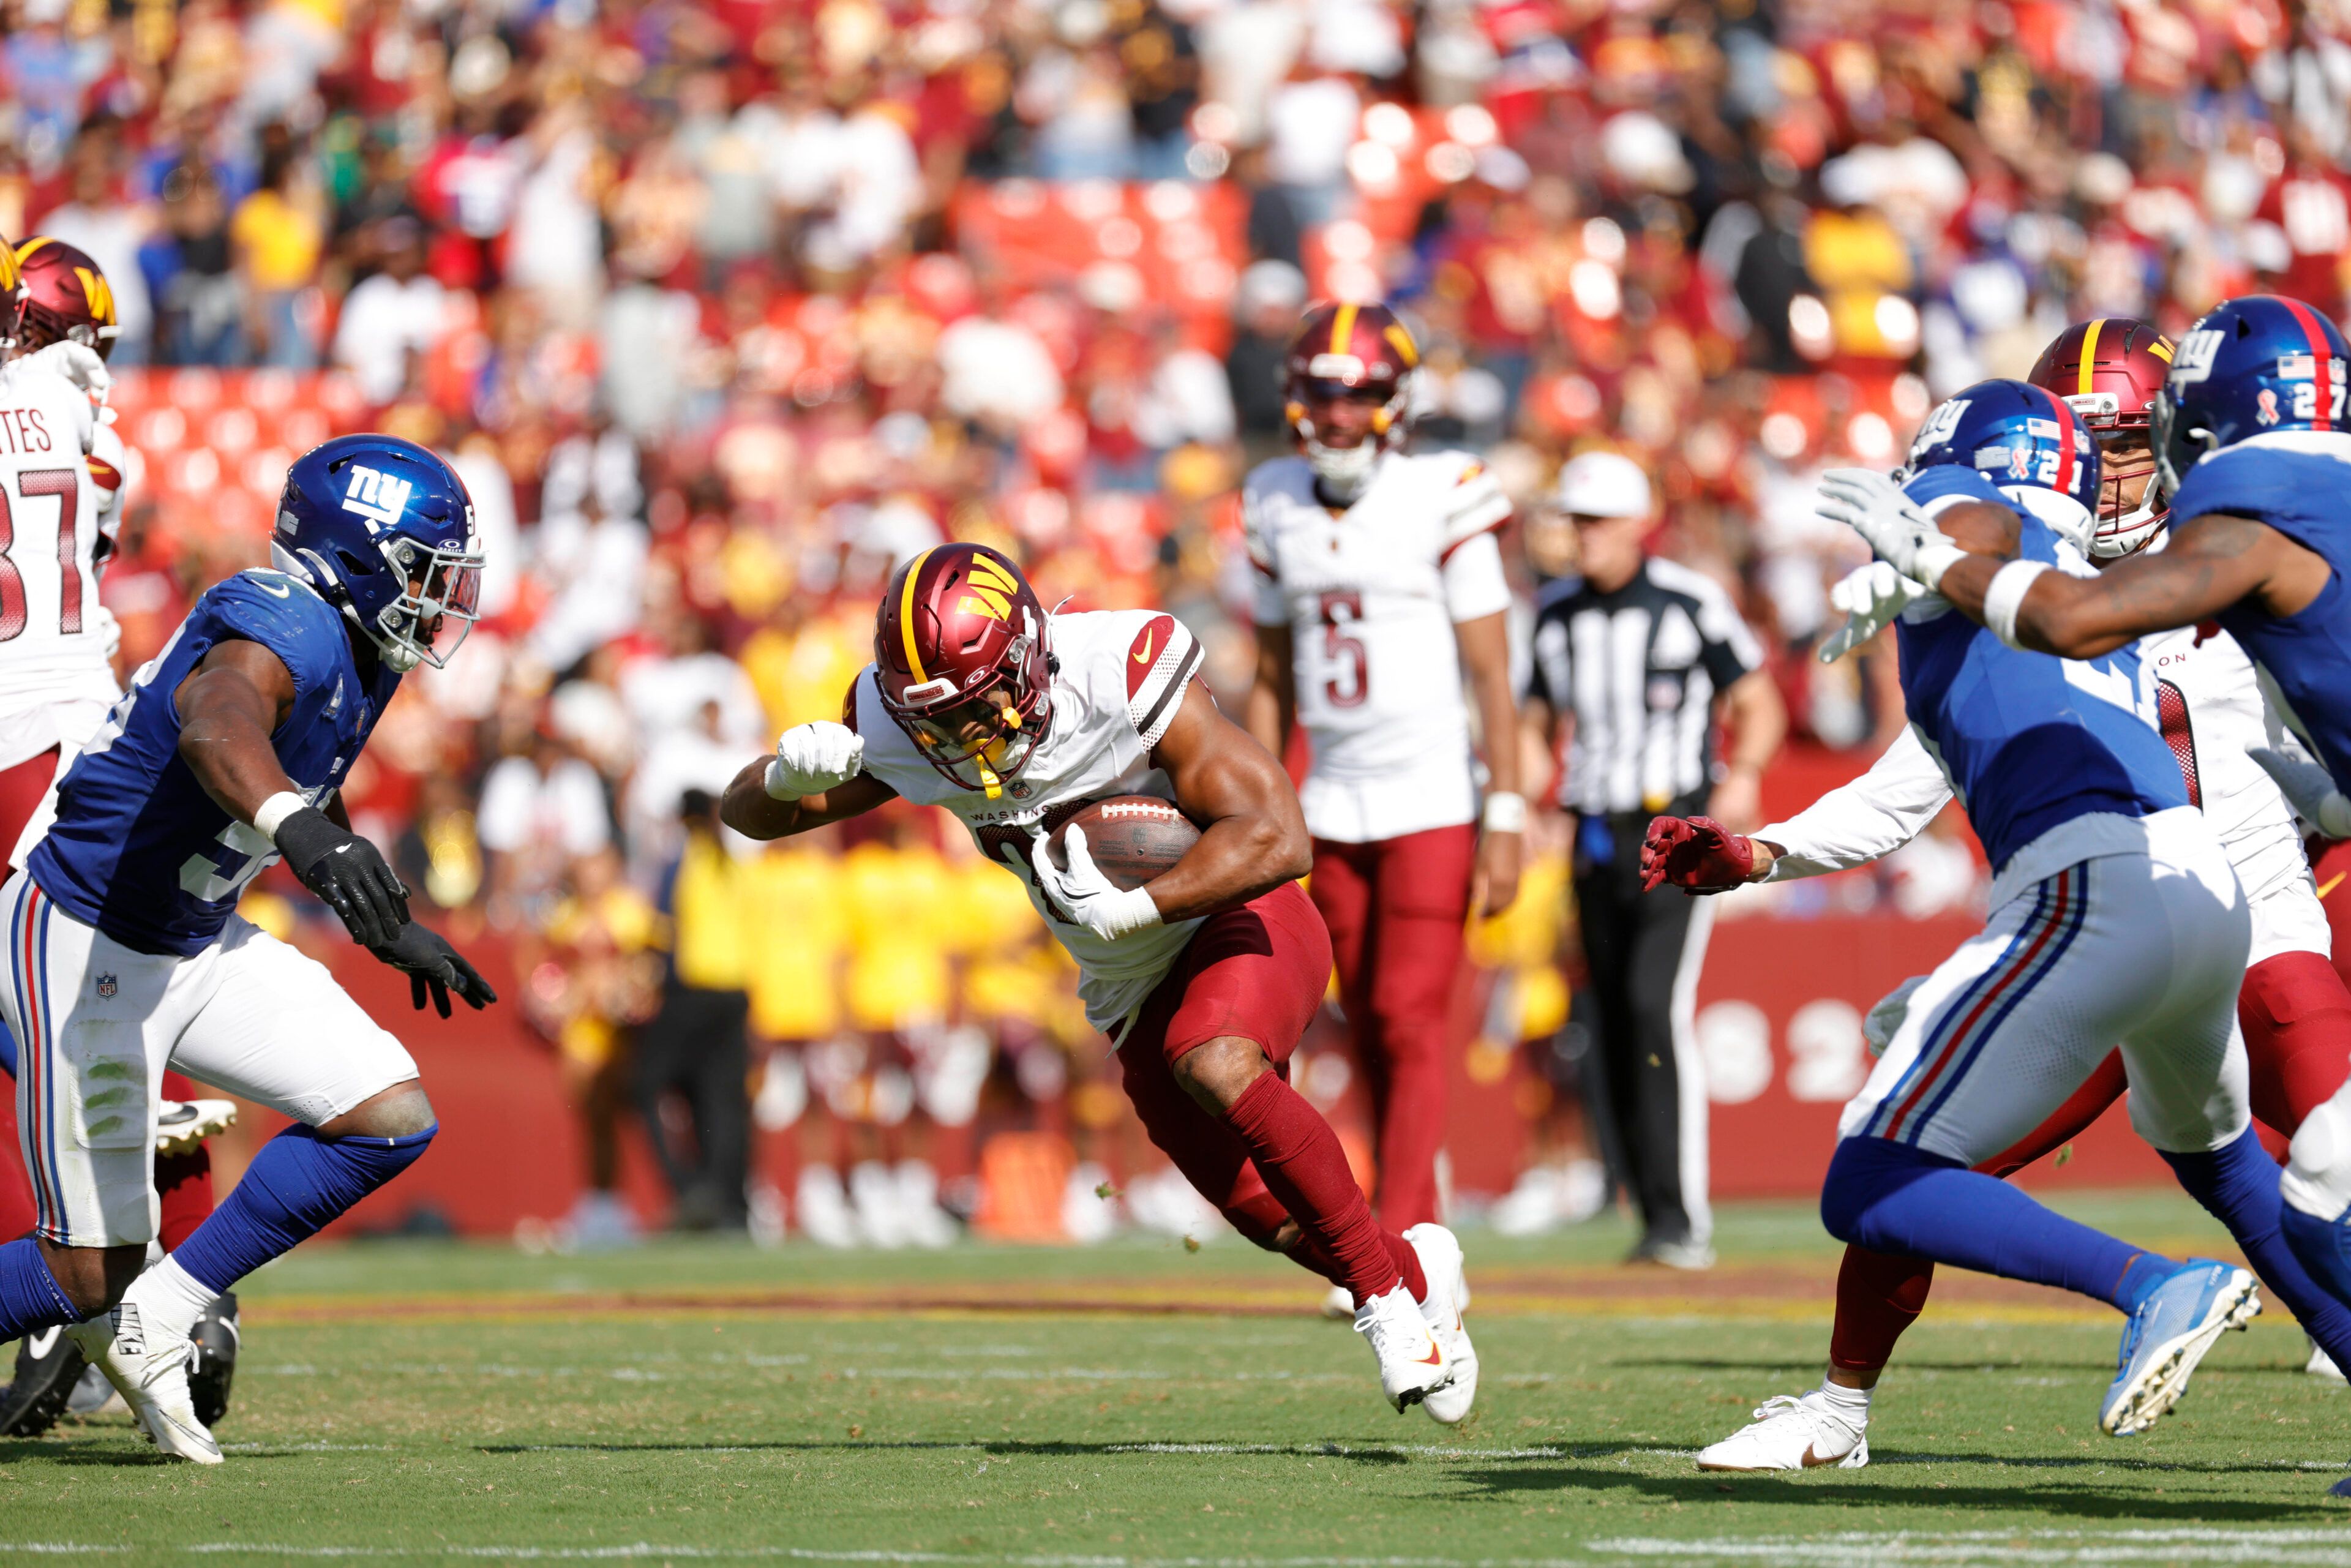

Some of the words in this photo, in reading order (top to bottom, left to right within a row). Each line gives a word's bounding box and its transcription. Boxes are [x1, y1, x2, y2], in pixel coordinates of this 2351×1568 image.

[2293, 382, 2347, 421] 27
[0, 408, 51, 454] TES
[2037, 449, 2083, 495] 21
[1319, 590, 1367, 709] 5
[110, 1302, 148, 1355] NIKE
